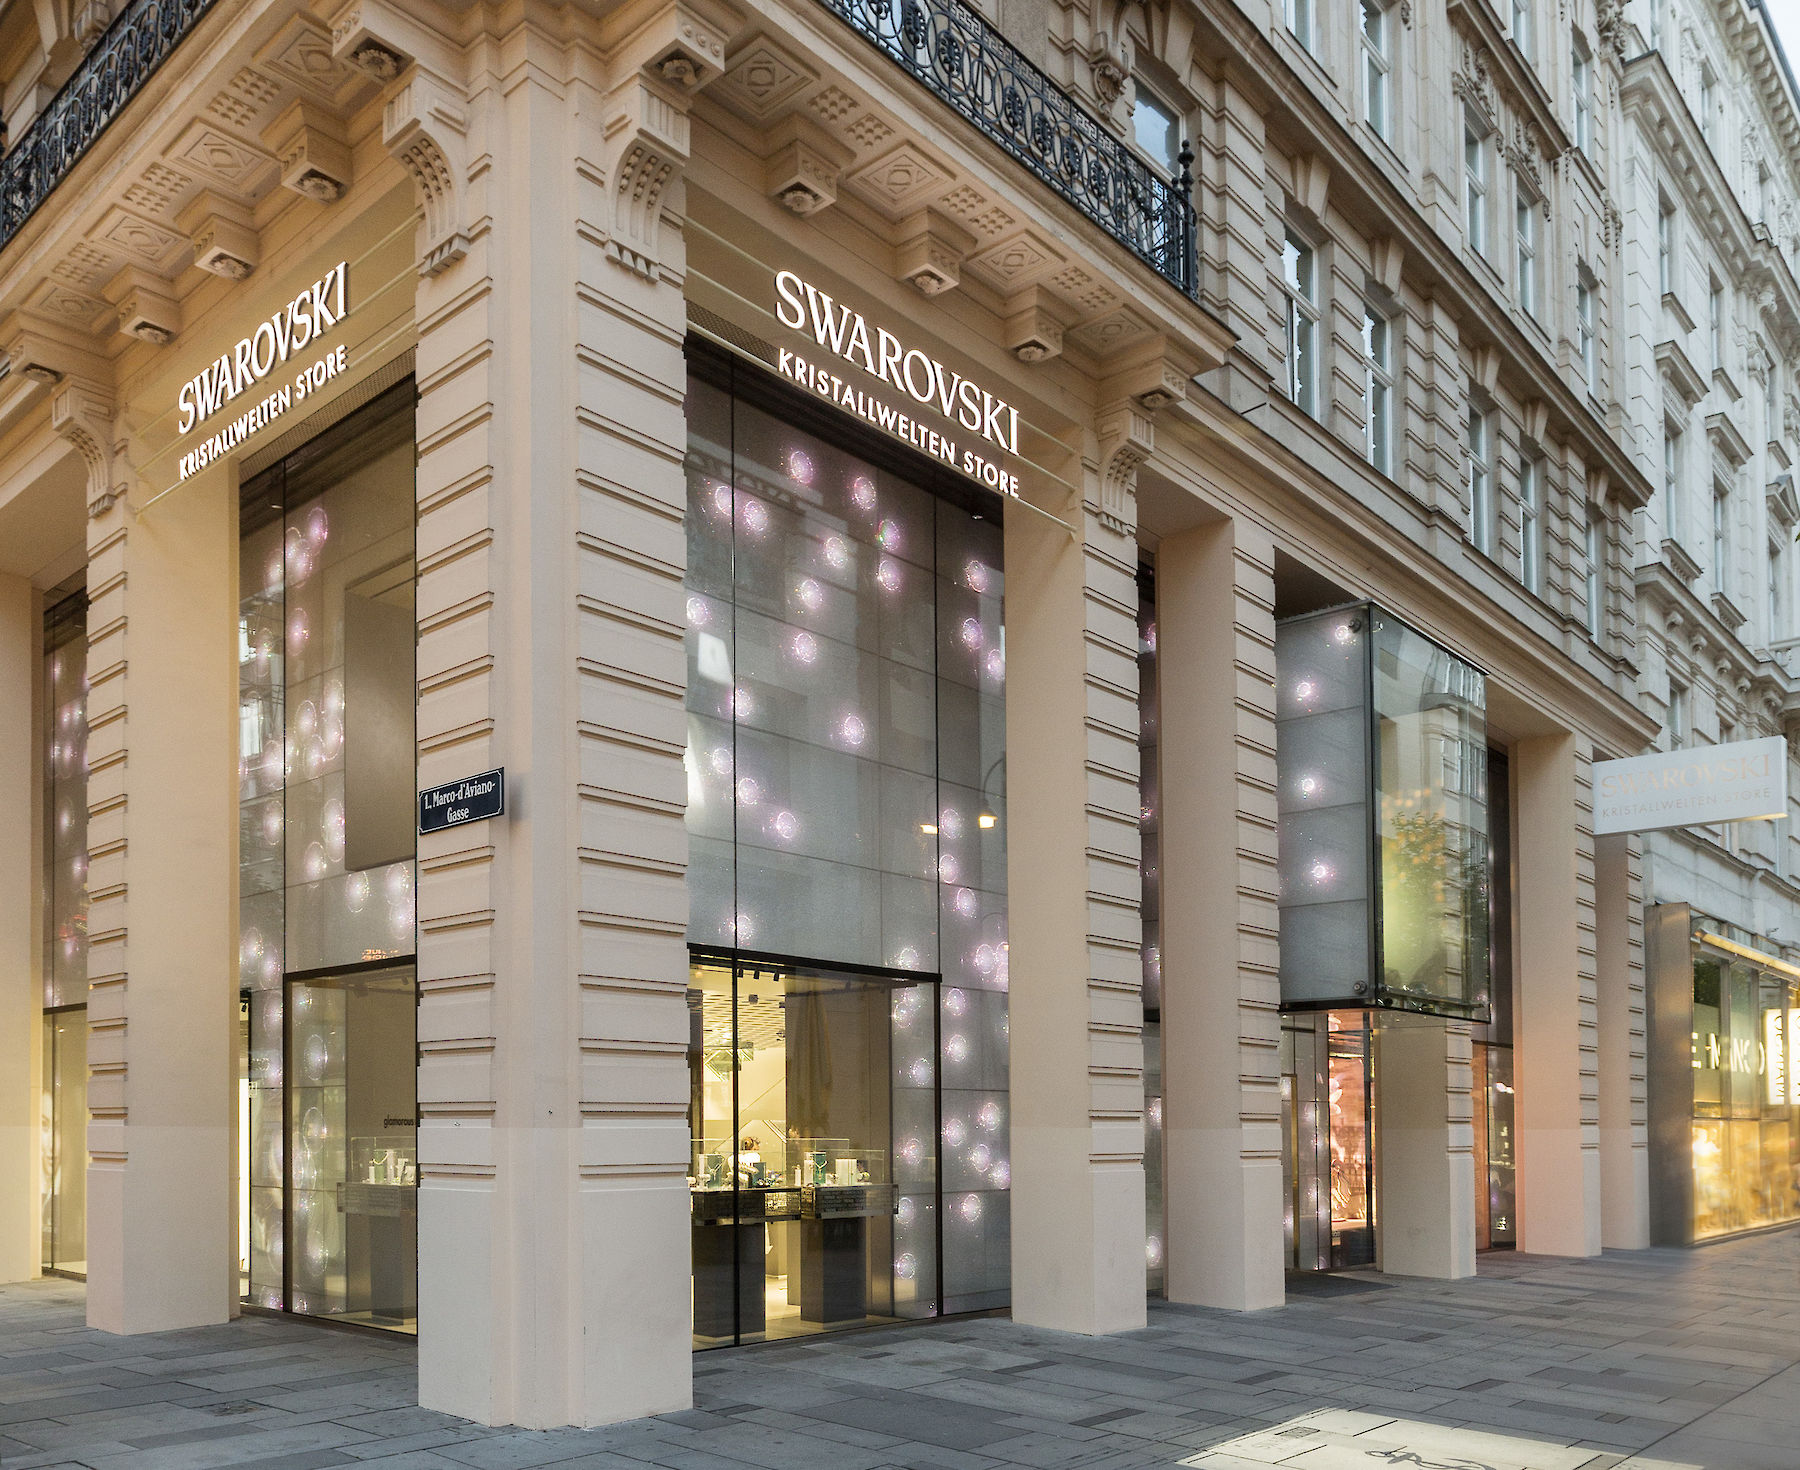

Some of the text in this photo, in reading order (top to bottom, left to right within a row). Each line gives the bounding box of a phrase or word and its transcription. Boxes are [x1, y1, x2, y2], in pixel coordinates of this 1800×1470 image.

[178, 261, 348, 434] SWAROVSKI
[775, 270, 1019, 456] SWAROVSKI
[179, 344, 348, 480] KRISTALLWELTEN STORE
[778, 348, 1019, 498] KRISTALLWELTEN STORE
[432, 780, 496, 808] Marco-d'Aviano-
[446, 806, 470, 823] Gasse
[1601, 754, 1770, 798] SWAROVSKI
[1602, 795, 1718, 817] KRISTALLWELTEN
